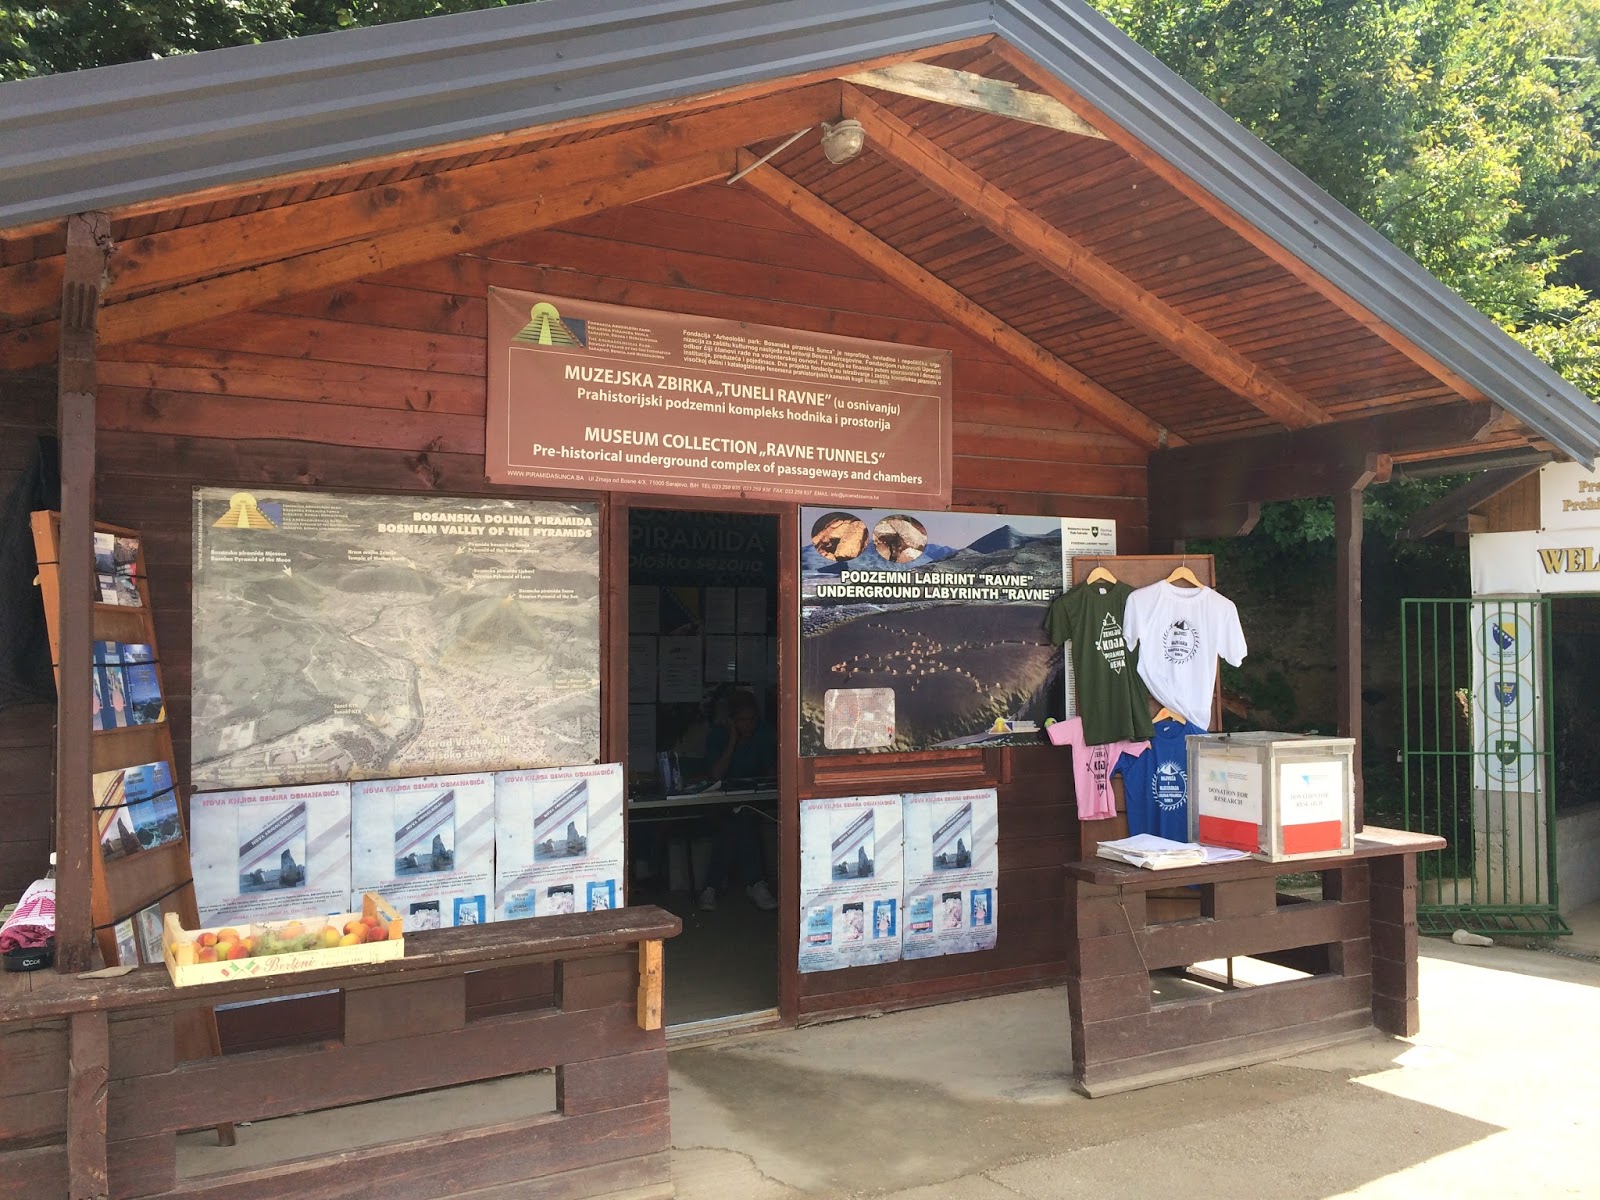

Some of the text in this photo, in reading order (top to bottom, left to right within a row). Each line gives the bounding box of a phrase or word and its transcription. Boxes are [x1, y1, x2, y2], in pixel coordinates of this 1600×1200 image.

[682, 329, 710, 339] Fondacija
[763, 340, 789, 348] Bosanska
[791, 344, 814, 352] piramida
[820, 360, 844, 368] Fondacija
[564, 364, 653, 388] MUZEJSKA
[657, 374, 713, 394] ZBIRKA
[833, 397, 843, 410] (u
[846, 398, 900, 416] osnivanju)
[577, 387, 890, 432] Prahistorijski podzemni kompleks hodnika i prostorija
[584, 426, 659, 447] MUSEUM
[662, 433, 756, 455] COLLECTION
[533, 443, 922, 484] Pre-historical underground complex of passageways and chambers
[507, 470, 583, 480] WWW.PIRAMIDASUNCA.BA
[413, 512, 592, 526] BOSANSKA DOLINA PIRAMIDA
[378, 523, 593, 538] BOSNIAN VALLEY OF THE PYRAMIDS
[1537, 547, 1600, 574] WEL
[841, 571, 1034, 587] PODZEMNI LABIRINT "RAVNE"
[816, 585, 1056, 601] UNDERGROUND LABYRINTH "RAVNE"
[1102, 637, 1125, 651] KOJA
[428, 738, 453, 748] Grad
[455, 736, 491, 747] Visoko,
[1208, 787, 1249, 799] DONATION FOR
[1213, 795, 1243, 806] RESEARCH
[203, 799, 226, 807] NOVA
[228, 796, 257, 804] KNJIGA
